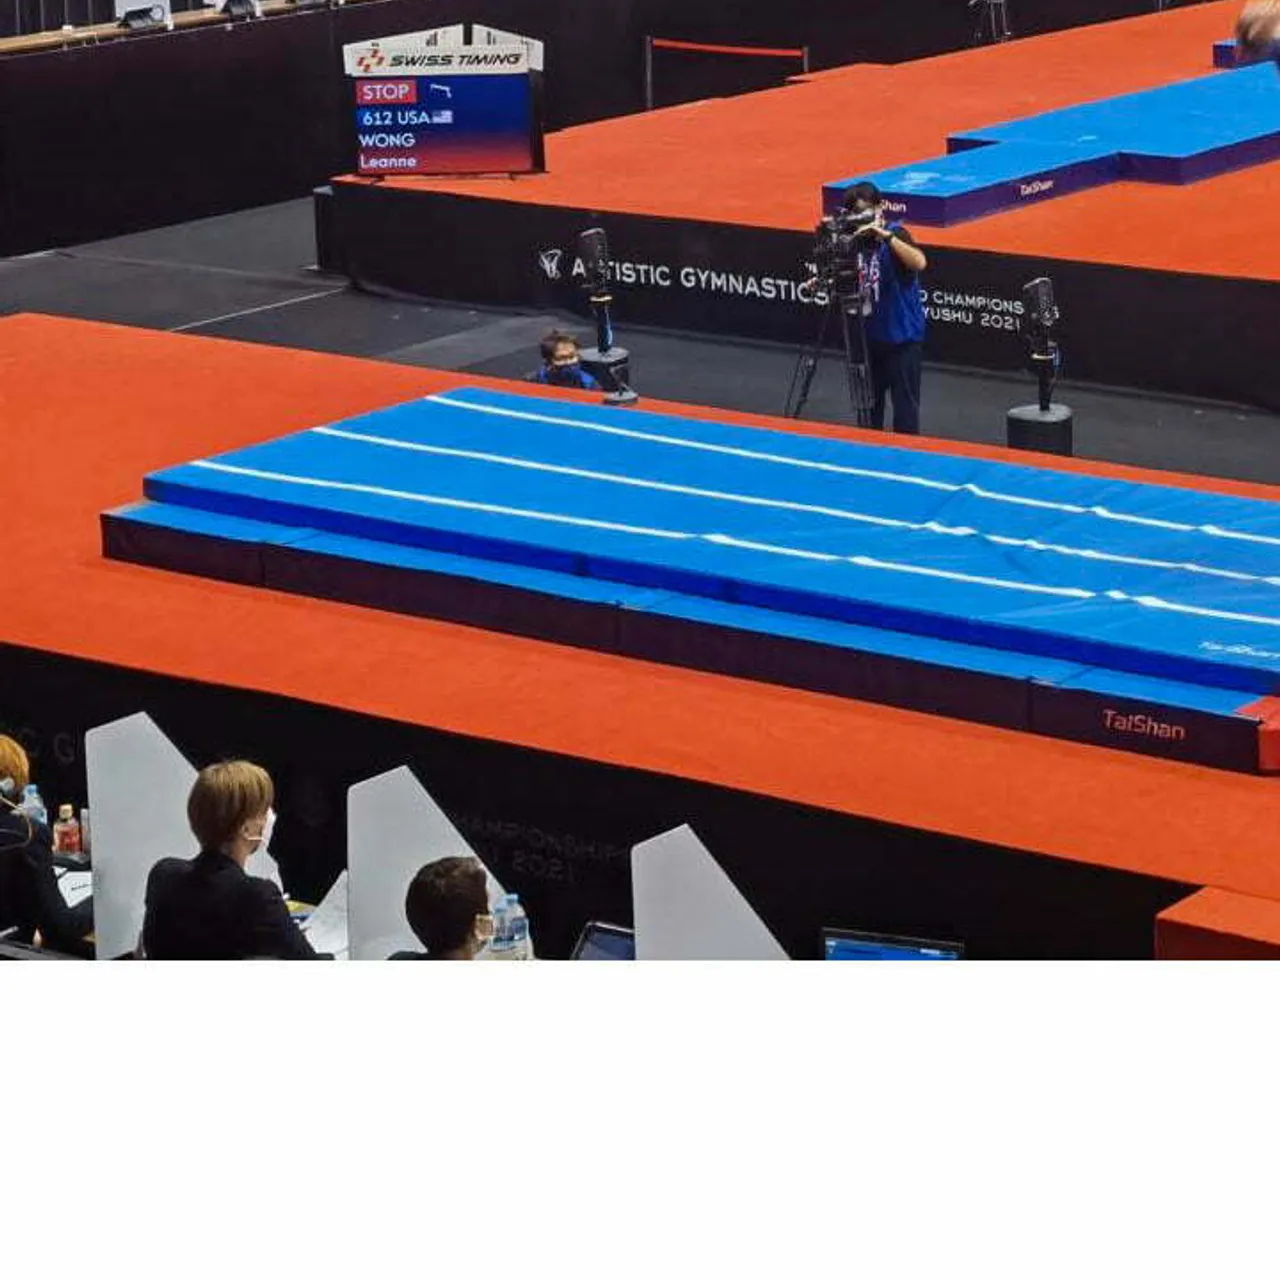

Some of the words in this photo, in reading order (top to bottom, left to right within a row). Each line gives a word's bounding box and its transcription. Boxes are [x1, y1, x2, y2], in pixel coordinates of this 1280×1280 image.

[390, 54, 454, 67] SWISS
[458, 53, 523, 66] TIMING
[362, 84, 410, 100] STOP
[362, 111, 392, 125] 612
[397, 110, 430, 125] USA
[358, 133, 416, 147] WONG
[360, 154, 417, 169] Leanne
[680, 266, 830, 306] GYMNASTICS
[981, 313, 1020, 332] 2021
[1102, 708, 1186, 741] TaiShan
